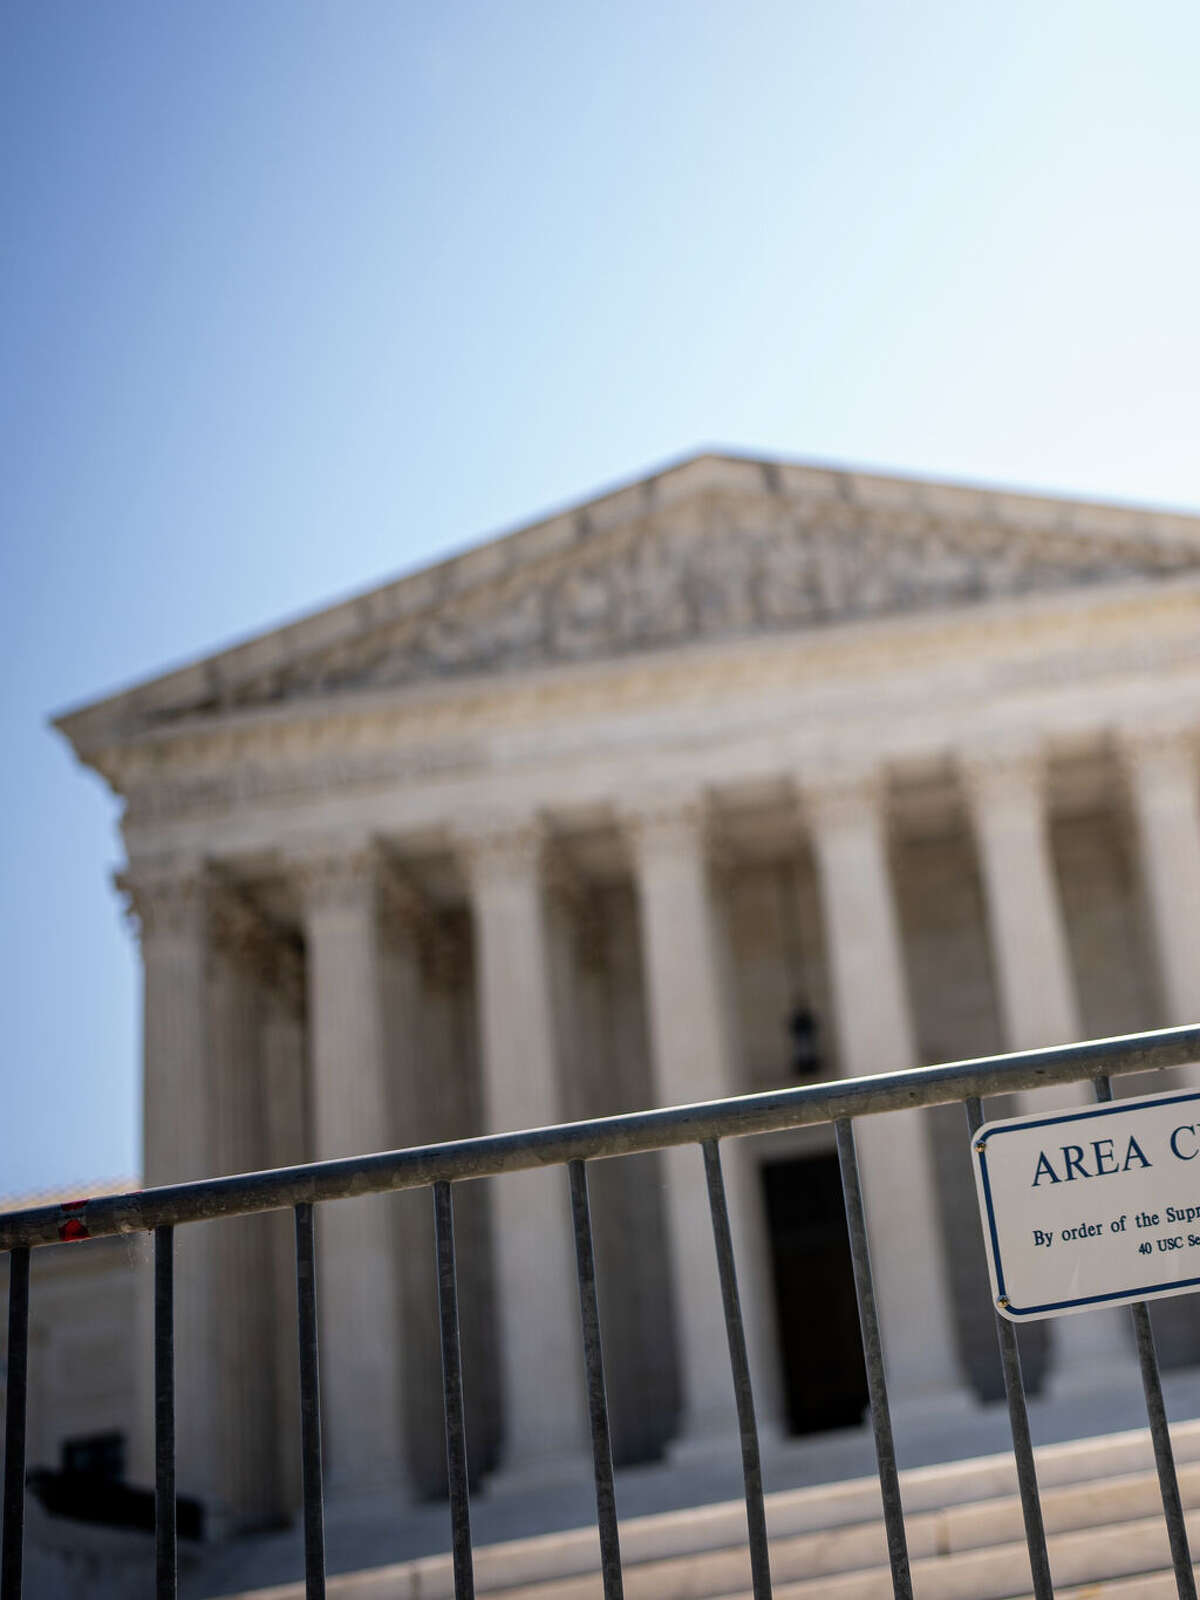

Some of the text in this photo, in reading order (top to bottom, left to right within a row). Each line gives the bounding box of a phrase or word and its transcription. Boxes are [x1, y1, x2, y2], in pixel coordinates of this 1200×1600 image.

[1030, 1135, 1153, 1188] AREA
[1032, 1230, 1054, 1248] By
[1061, 1222, 1103, 1242] order
[1110, 1215, 1127, 1233] of
[1135, 1211, 1161, 1229] the
[1138, 1241, 1153, 1256] 40
[1157, 1236, 1184, 1253] USC
